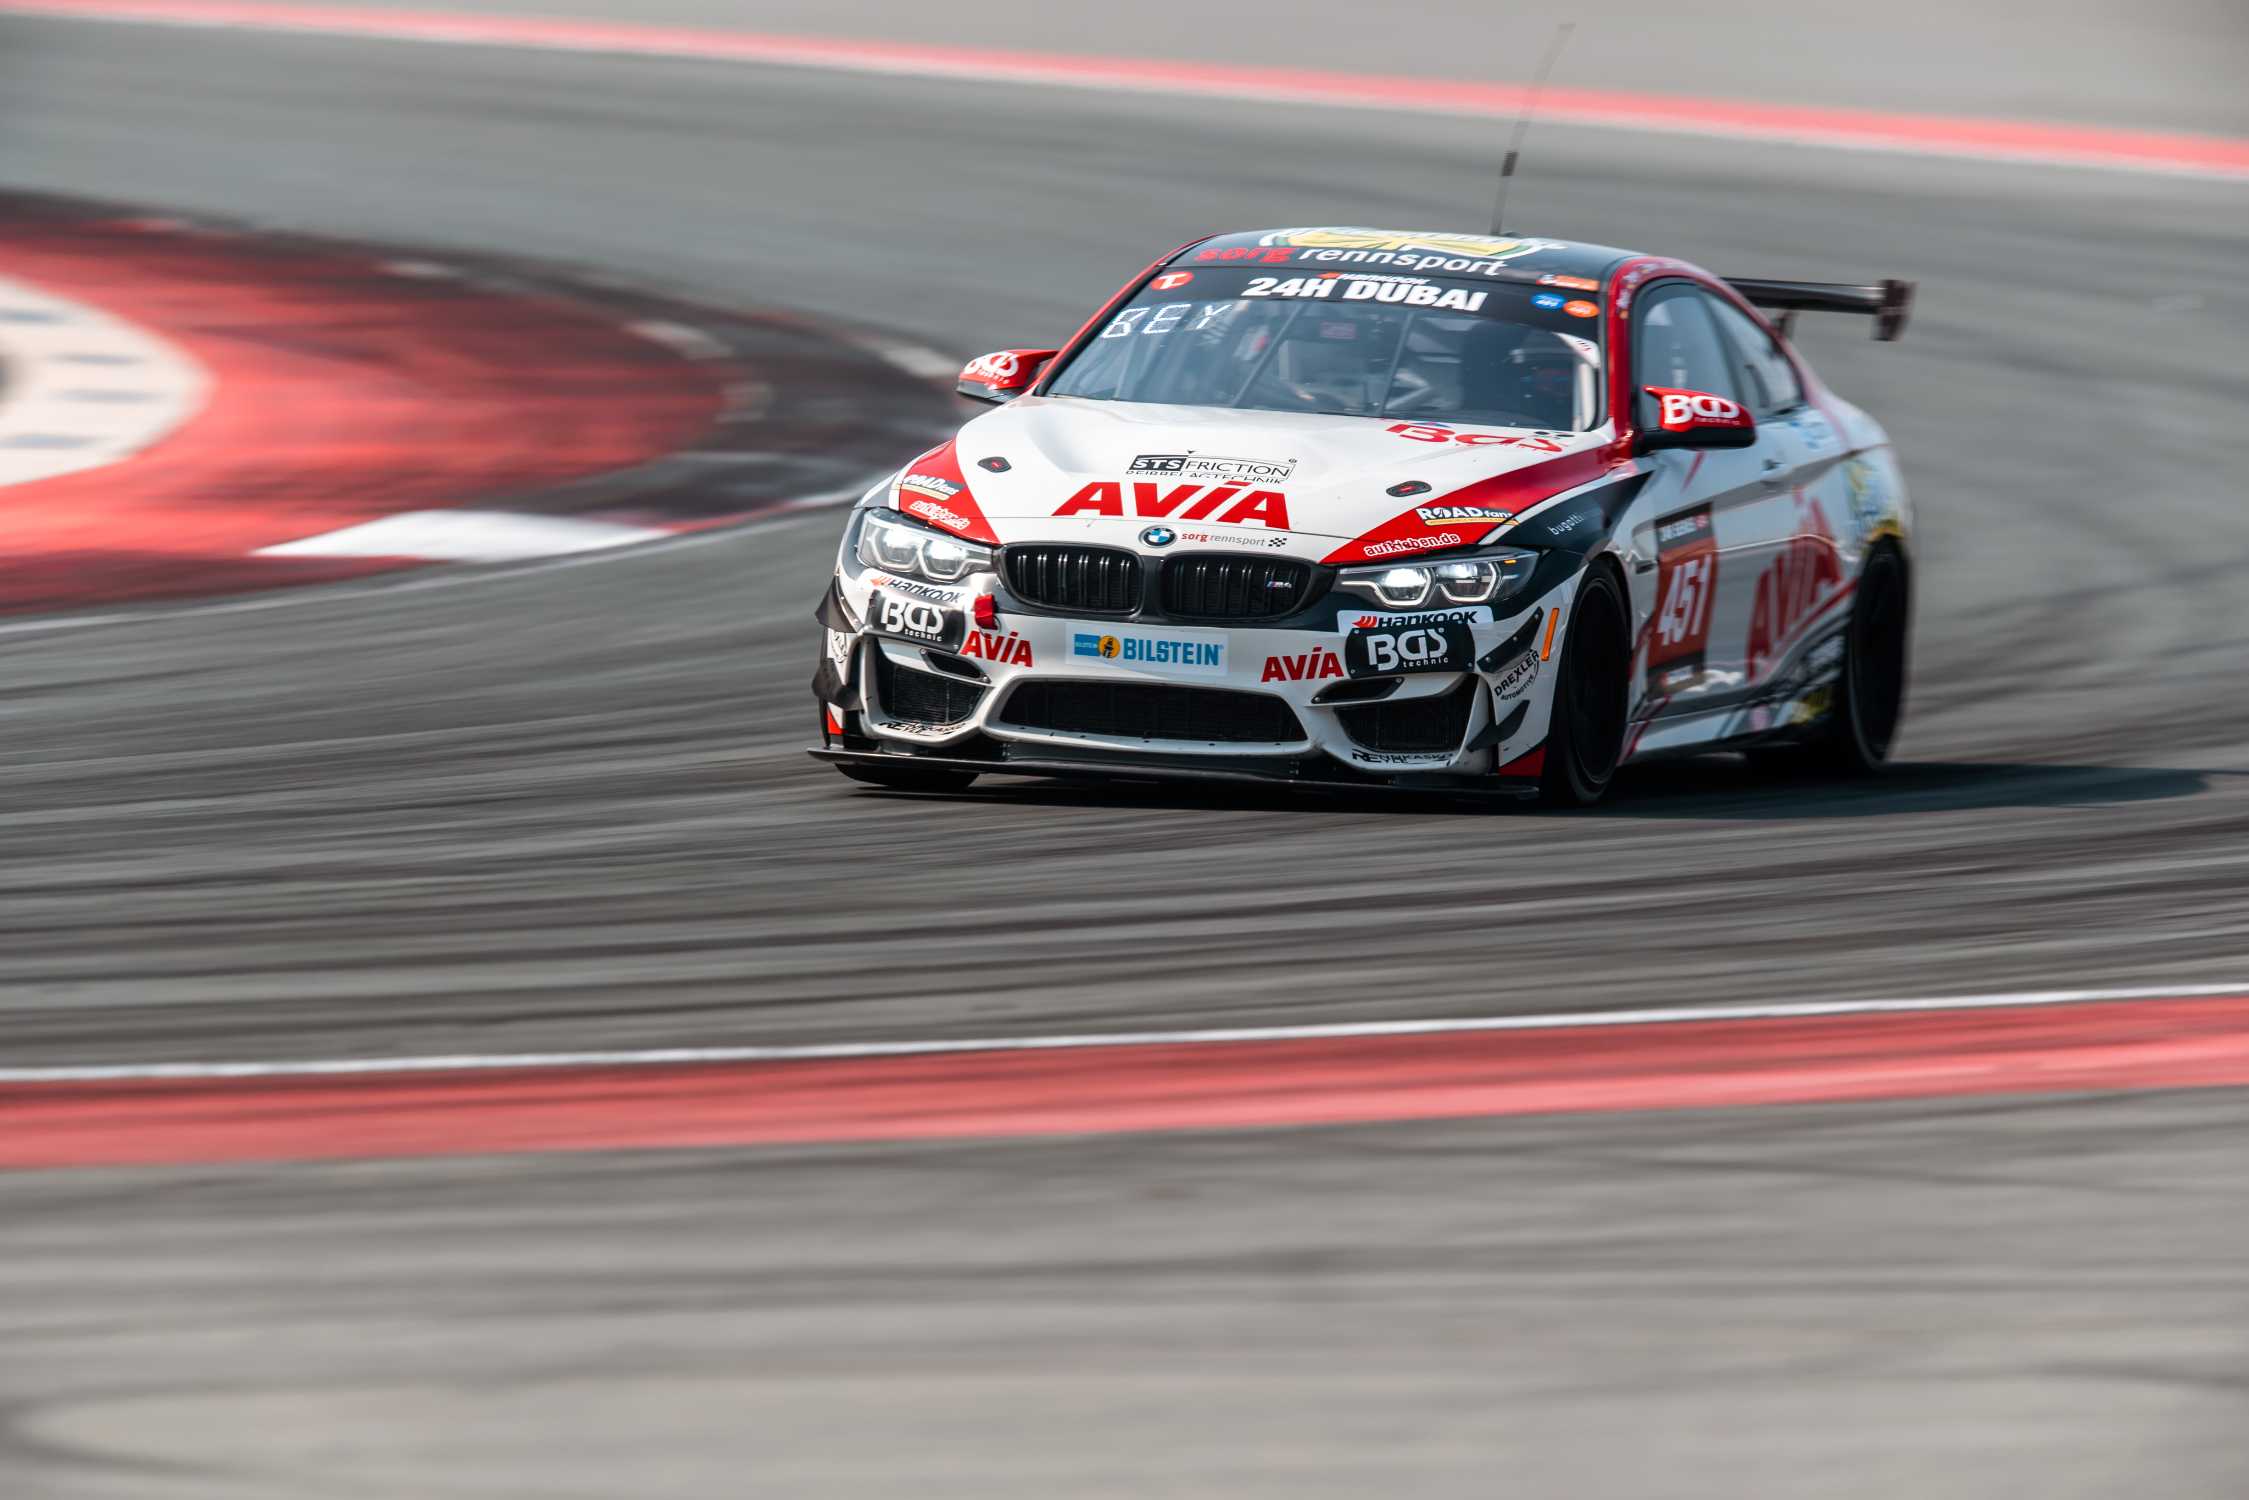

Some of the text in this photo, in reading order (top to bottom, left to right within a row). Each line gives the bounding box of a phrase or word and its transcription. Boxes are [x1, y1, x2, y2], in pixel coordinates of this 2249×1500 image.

[1298, 249, 1508, 276] rennsport
[1241, 277, 1489, 312] 24H DUBAI
[1132, 457, 1290, 477] STS FRICTION
[1181, 532, 1266, 547] sorg rennsport
[1657, 553, 1713, 646] 451
[1377, 610, 1478, 628] HANKOOK
[904, 628, 943, 642] technic
[1122, 637, 1219, 666] BILSTEIN
[1403, 657, 1449, 669] technic
